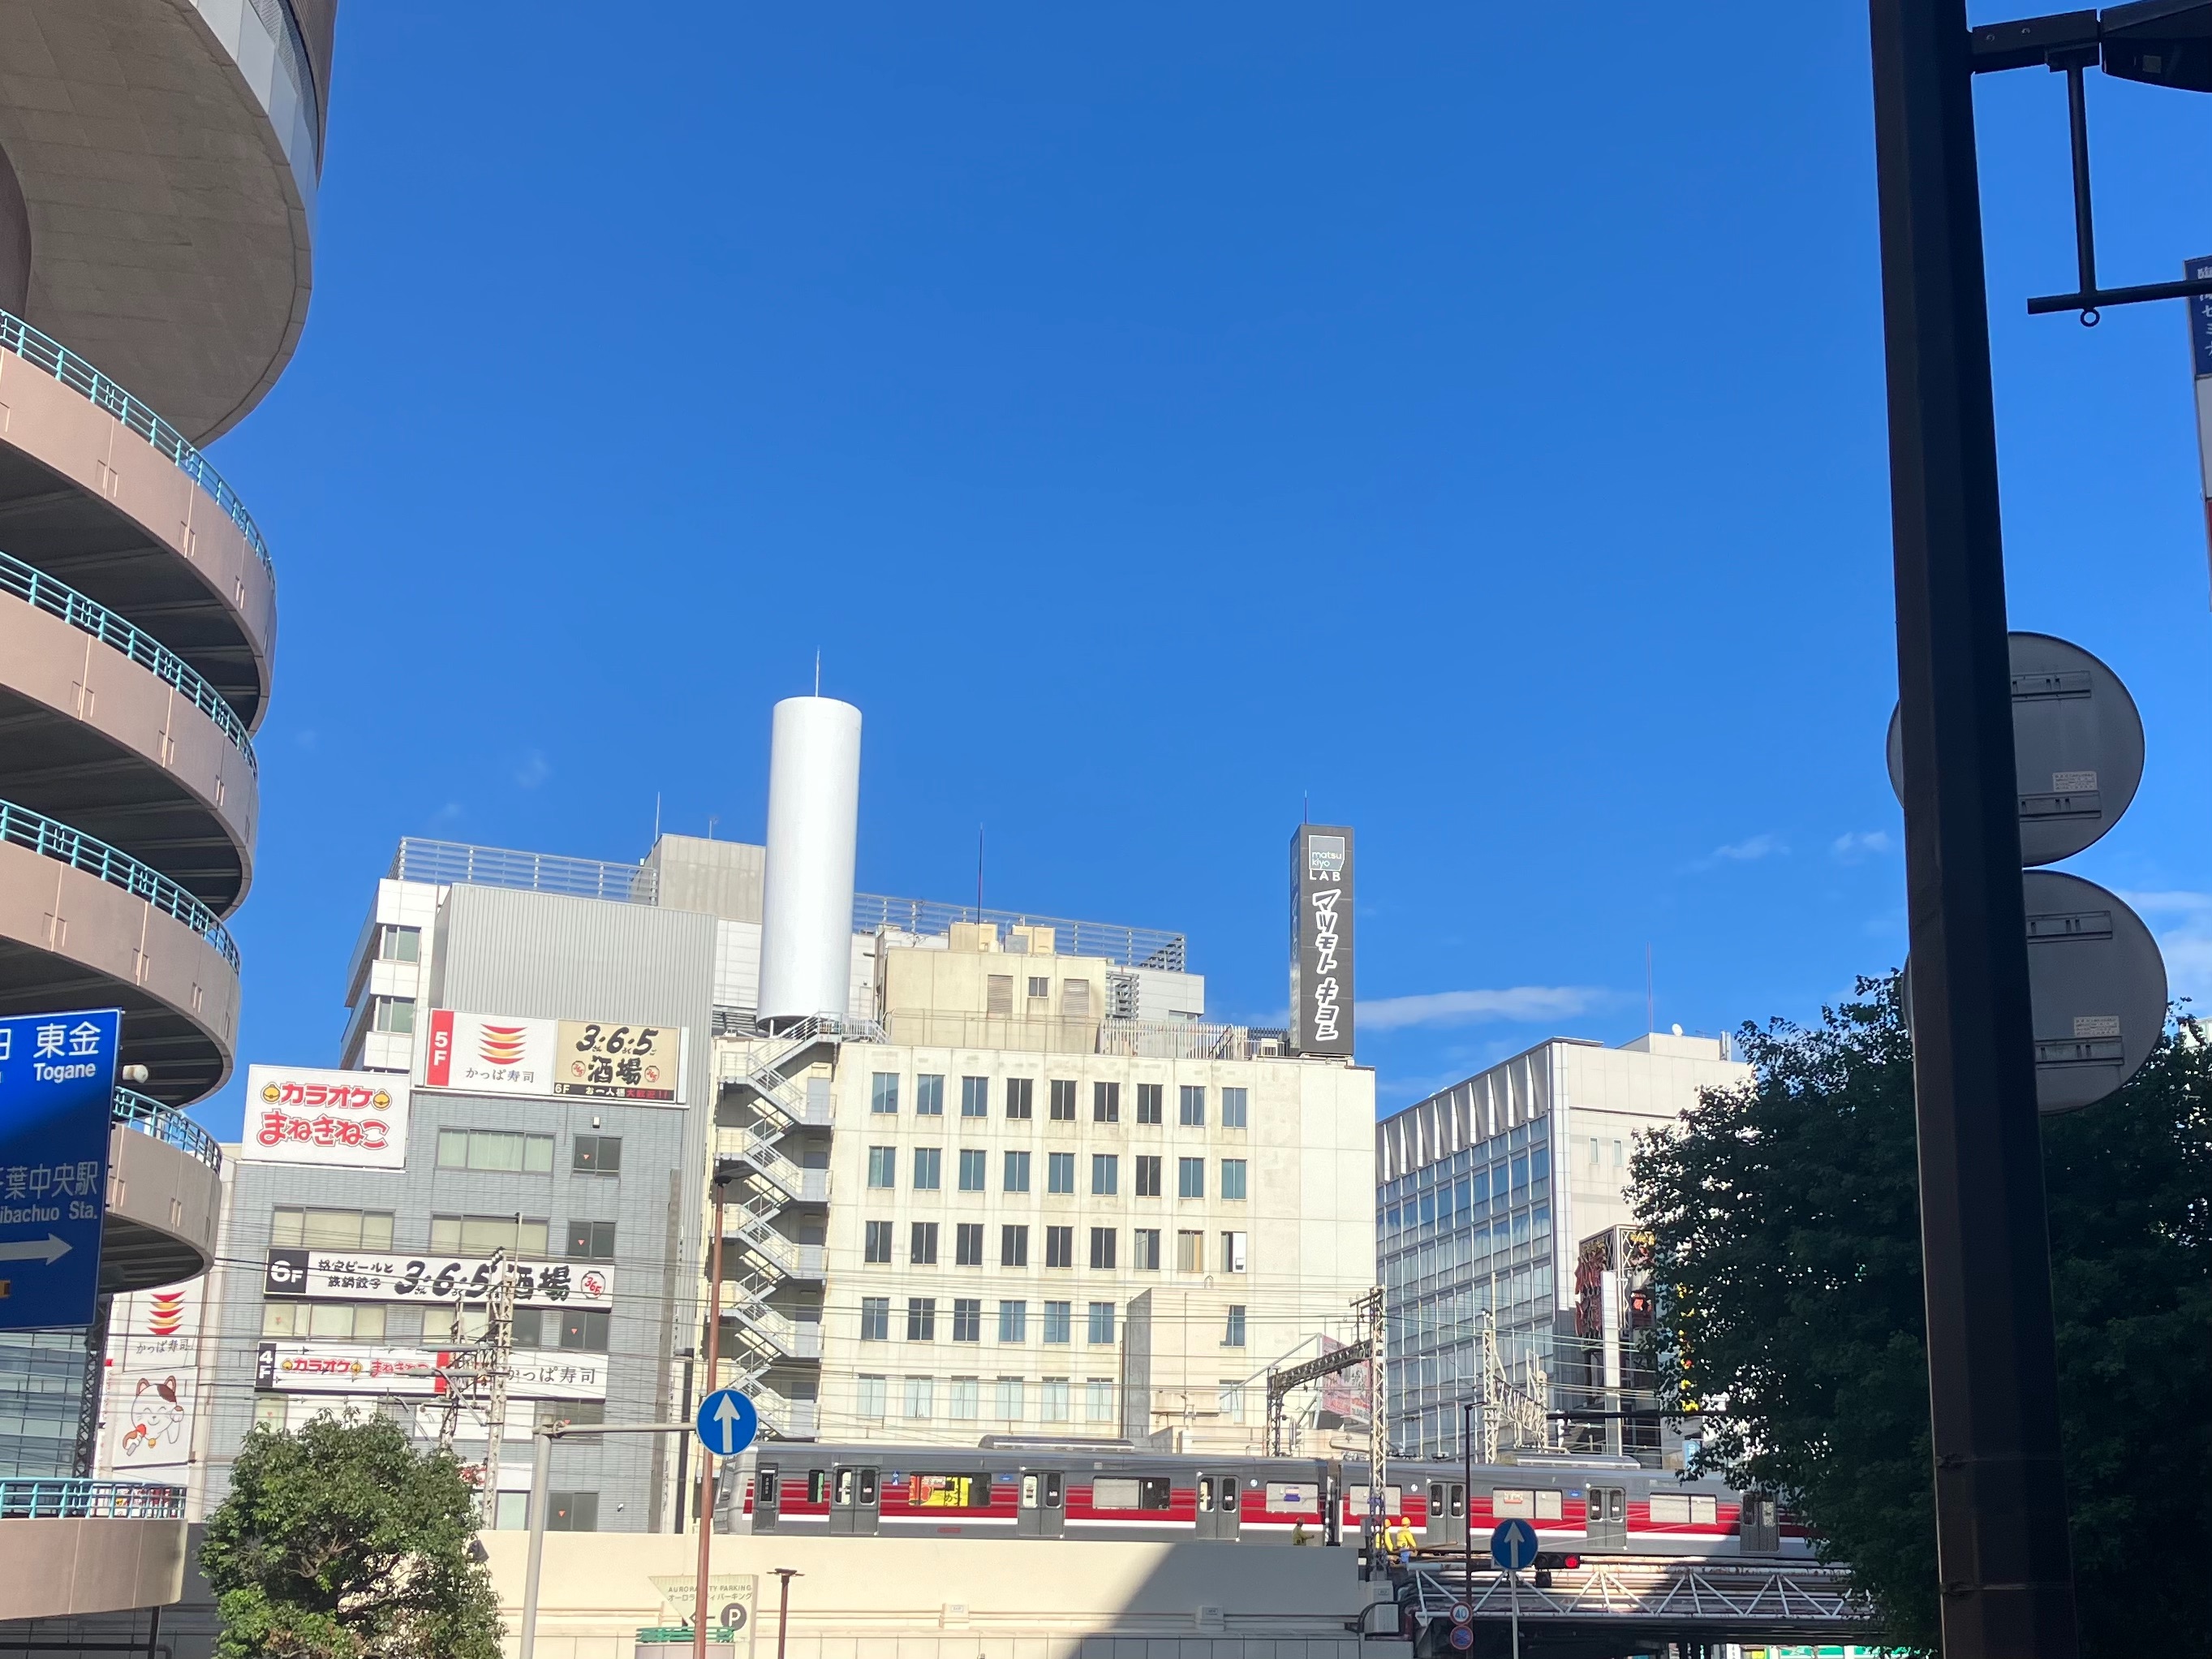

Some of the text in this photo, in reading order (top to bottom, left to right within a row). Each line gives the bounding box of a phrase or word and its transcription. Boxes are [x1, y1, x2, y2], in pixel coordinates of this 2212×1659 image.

[1311, 858, 1330, 869] kiyo
[1309, 869, 1341, 881] LAB
[33, 1021, 101, 1058] 東金
[434, 1031, 448, 1066] 5F
[33, 1062, 96, 1084] Togane
[466, 1067, 535, 1084] かっぱ寿司
[587, 1055, 642, 1085] 酒場
[280, 1083, 373, 1108] カラオケ
[555, 1084, 570, 1094] 6F
[258, 1110, 389, 1149] まねきねこ
[0, 1161, 98, 1200] 葉中央駅
[69, 1200, 97, 1219] Sta.
[270, 1260, 303, 1283] 6F
[583, 1276, 603, 1296] 365
[292, 1359, 351, 1373] カラオケ
[1455, 1608, 1467, 1619] 40
